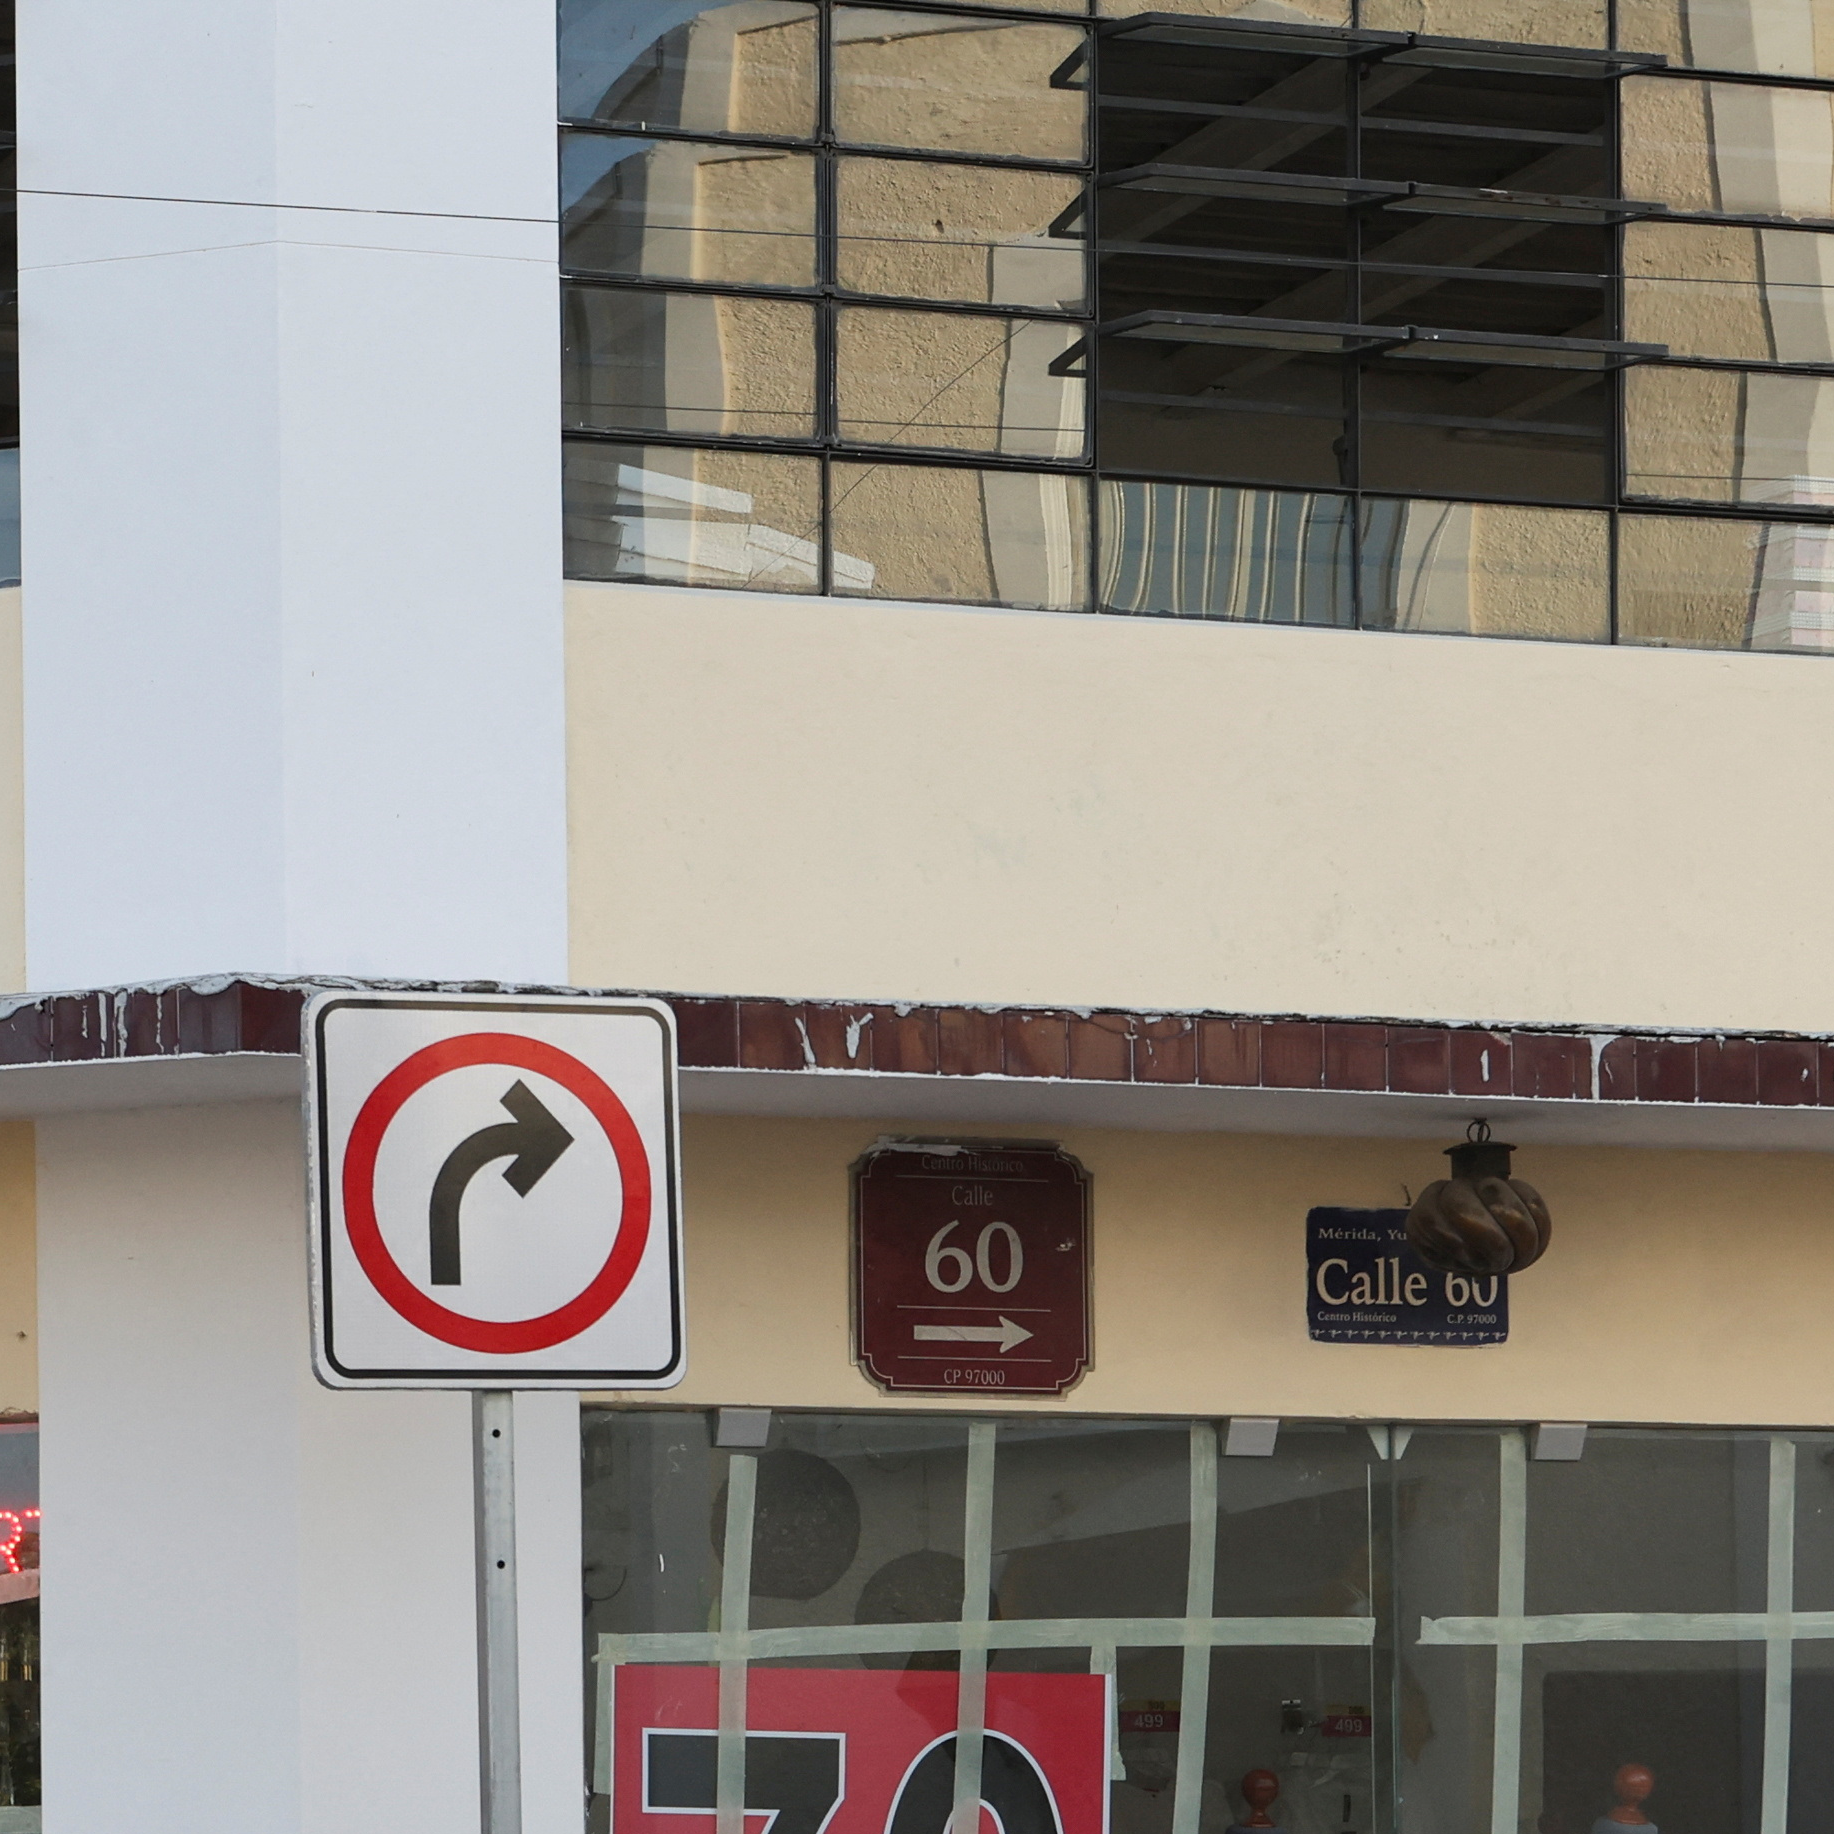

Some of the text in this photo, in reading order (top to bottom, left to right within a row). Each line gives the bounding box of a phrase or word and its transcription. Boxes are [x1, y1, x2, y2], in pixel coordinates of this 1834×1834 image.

[921, 1154, 964, 1170] Centro
[951, 1185, 994, 1206] Calle
[1318, 1227, 1381, 1242] Mérida,
[924, 1219, 1024, 1293] 60
[1316, 1256, 1428, 1306] Calle
[1317, 1311, 1397, 1323] Centro Histórico
[1466, 1314, 1497, 1324] 97000
[943, 1368, 1005, 1385] CP 97000
